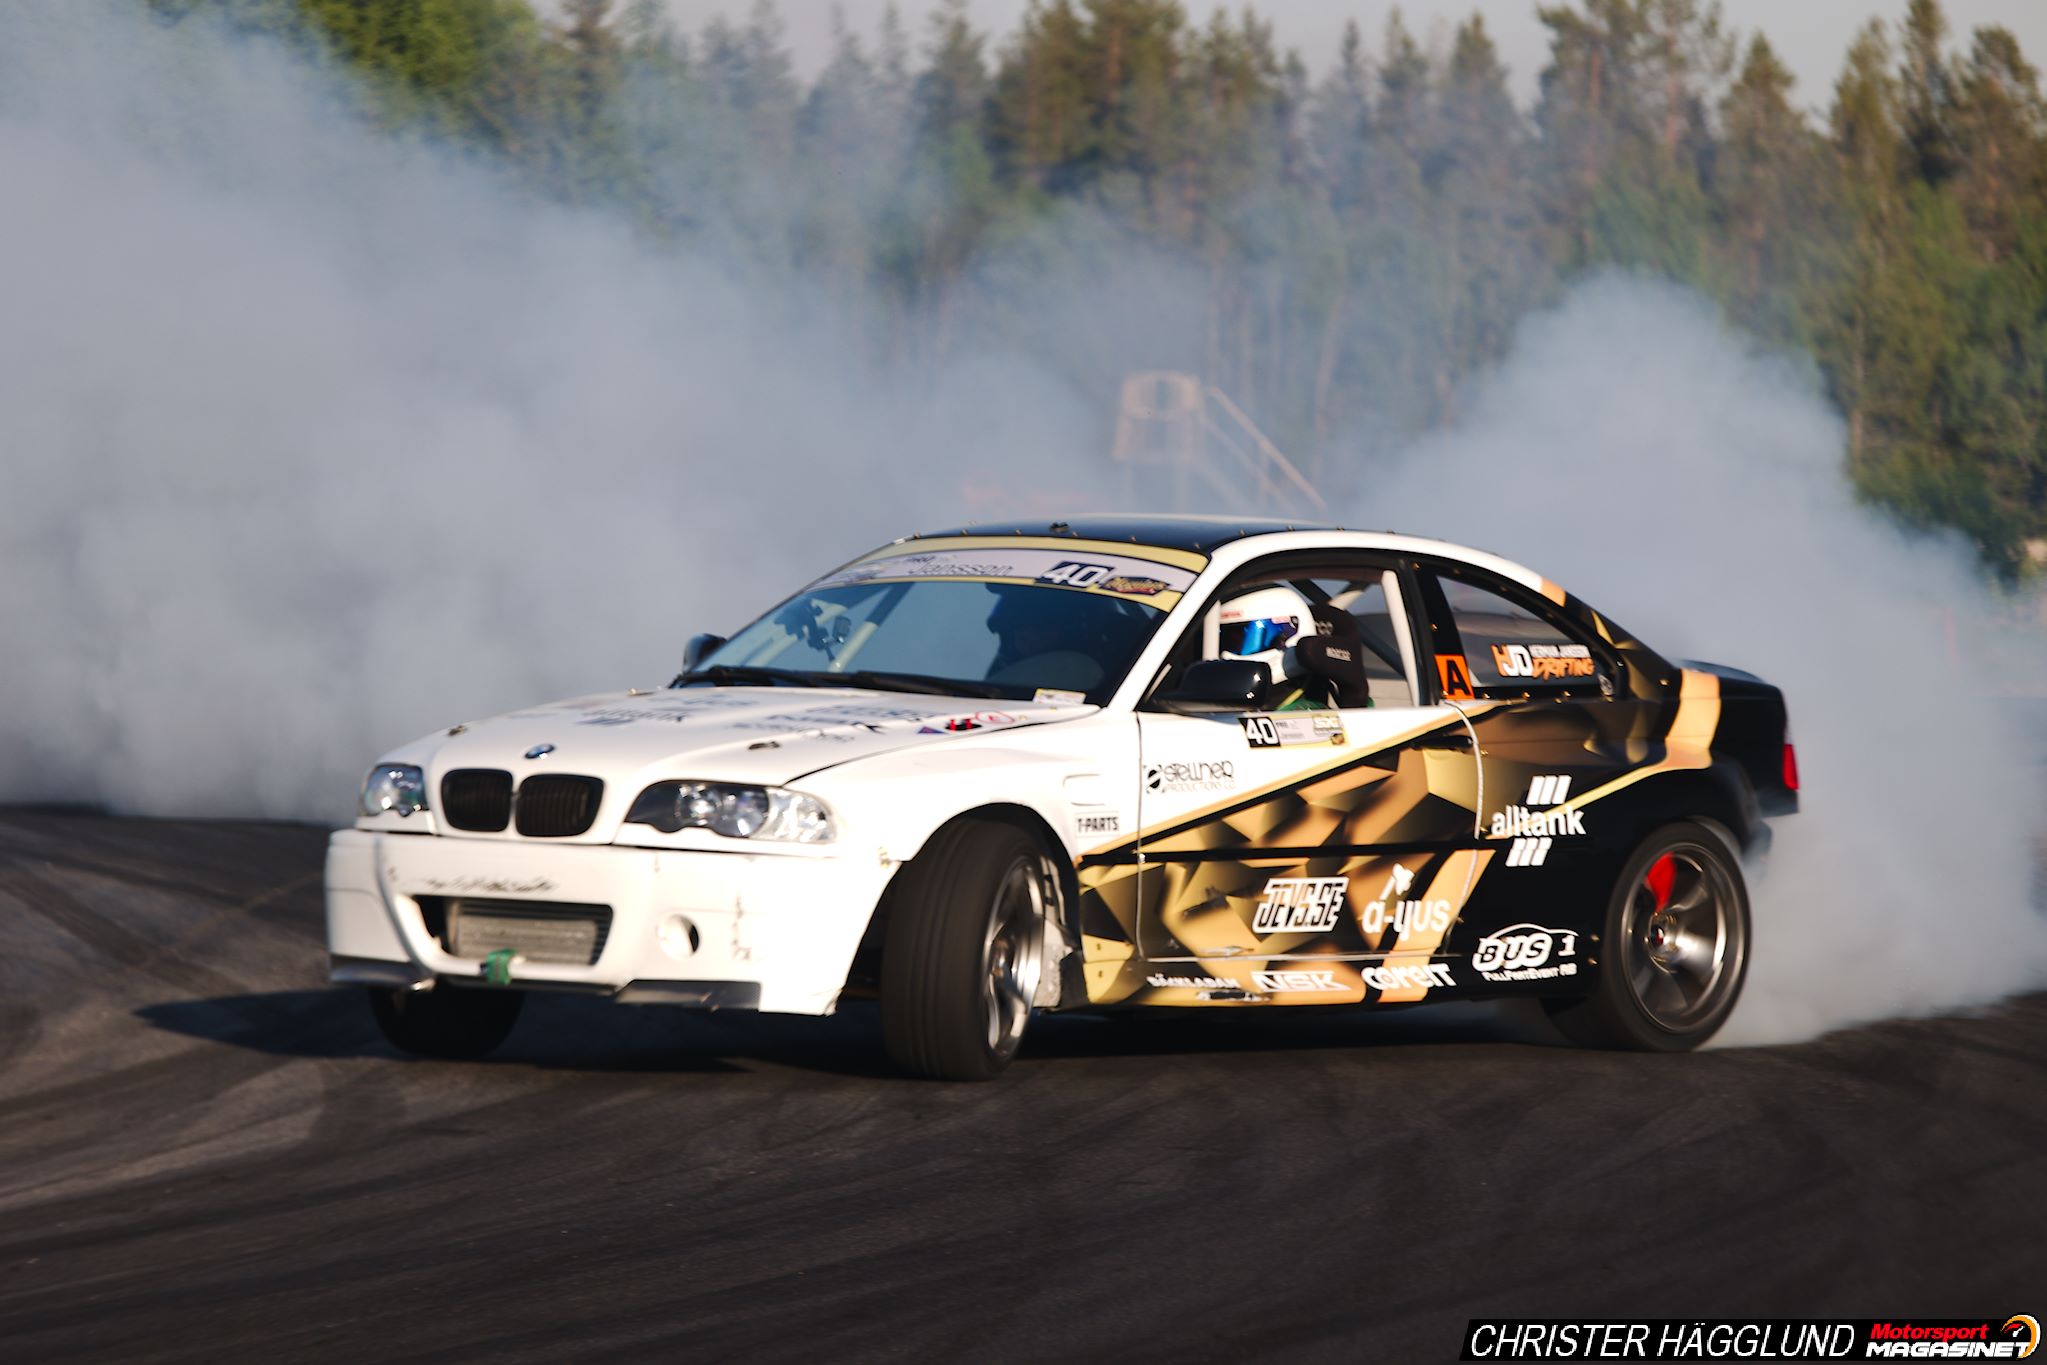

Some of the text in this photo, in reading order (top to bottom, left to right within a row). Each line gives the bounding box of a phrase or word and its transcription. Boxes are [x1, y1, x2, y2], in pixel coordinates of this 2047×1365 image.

[1042, 563, 1110, 587] 40
[1446, 658, 1471, 697] A
[1246, 718, 1279, 745] 40
[1491, 804, 1587, 837] alltank
